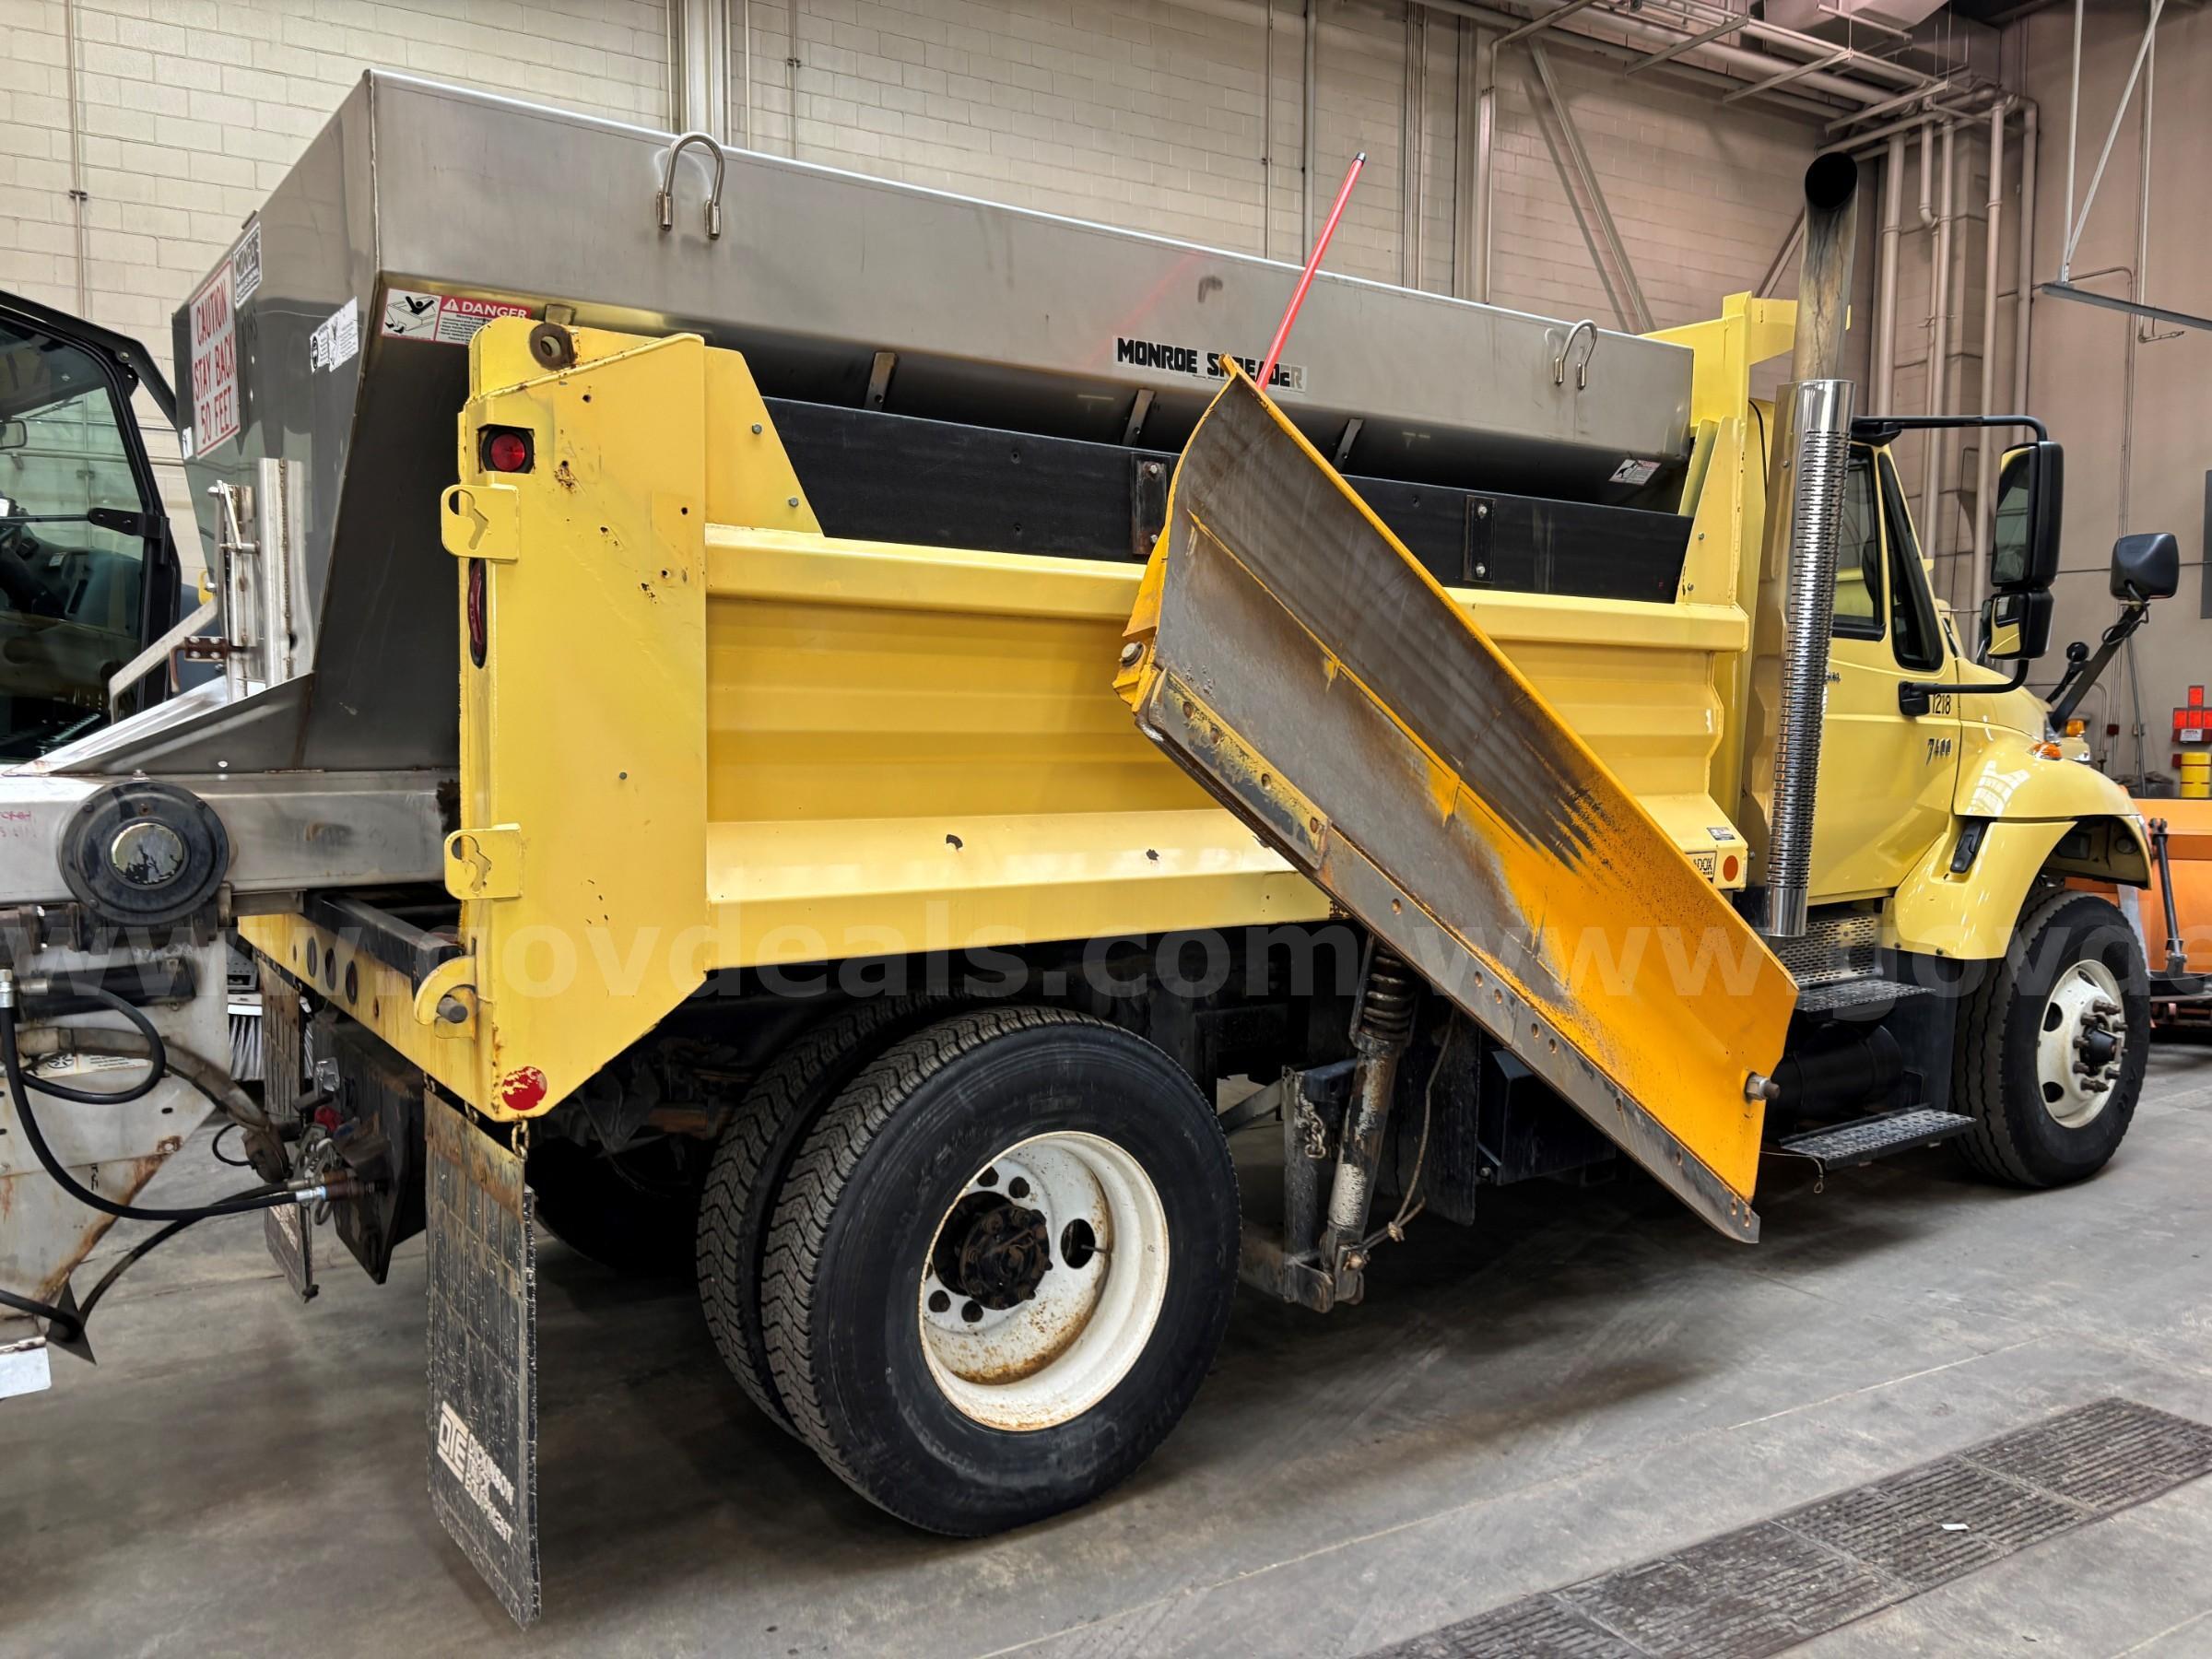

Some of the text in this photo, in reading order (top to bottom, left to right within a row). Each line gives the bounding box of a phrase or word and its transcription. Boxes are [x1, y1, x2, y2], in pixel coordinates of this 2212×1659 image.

[196, 279, 228, 347] CAUTION
[462, 301, 527, 318] DANGER
[194, 332, 236, 402] STAY BACK
[1117, 337, 1303, 389] MONROE SEDER
[201, 401, 212, 445] 50
[214, 385, 233, 437] FEET
[1932, 693, 1951, 714] 1218
[1926, 738, 1951, 766] 7400
[438, 1401, 468, 1483] DTE
